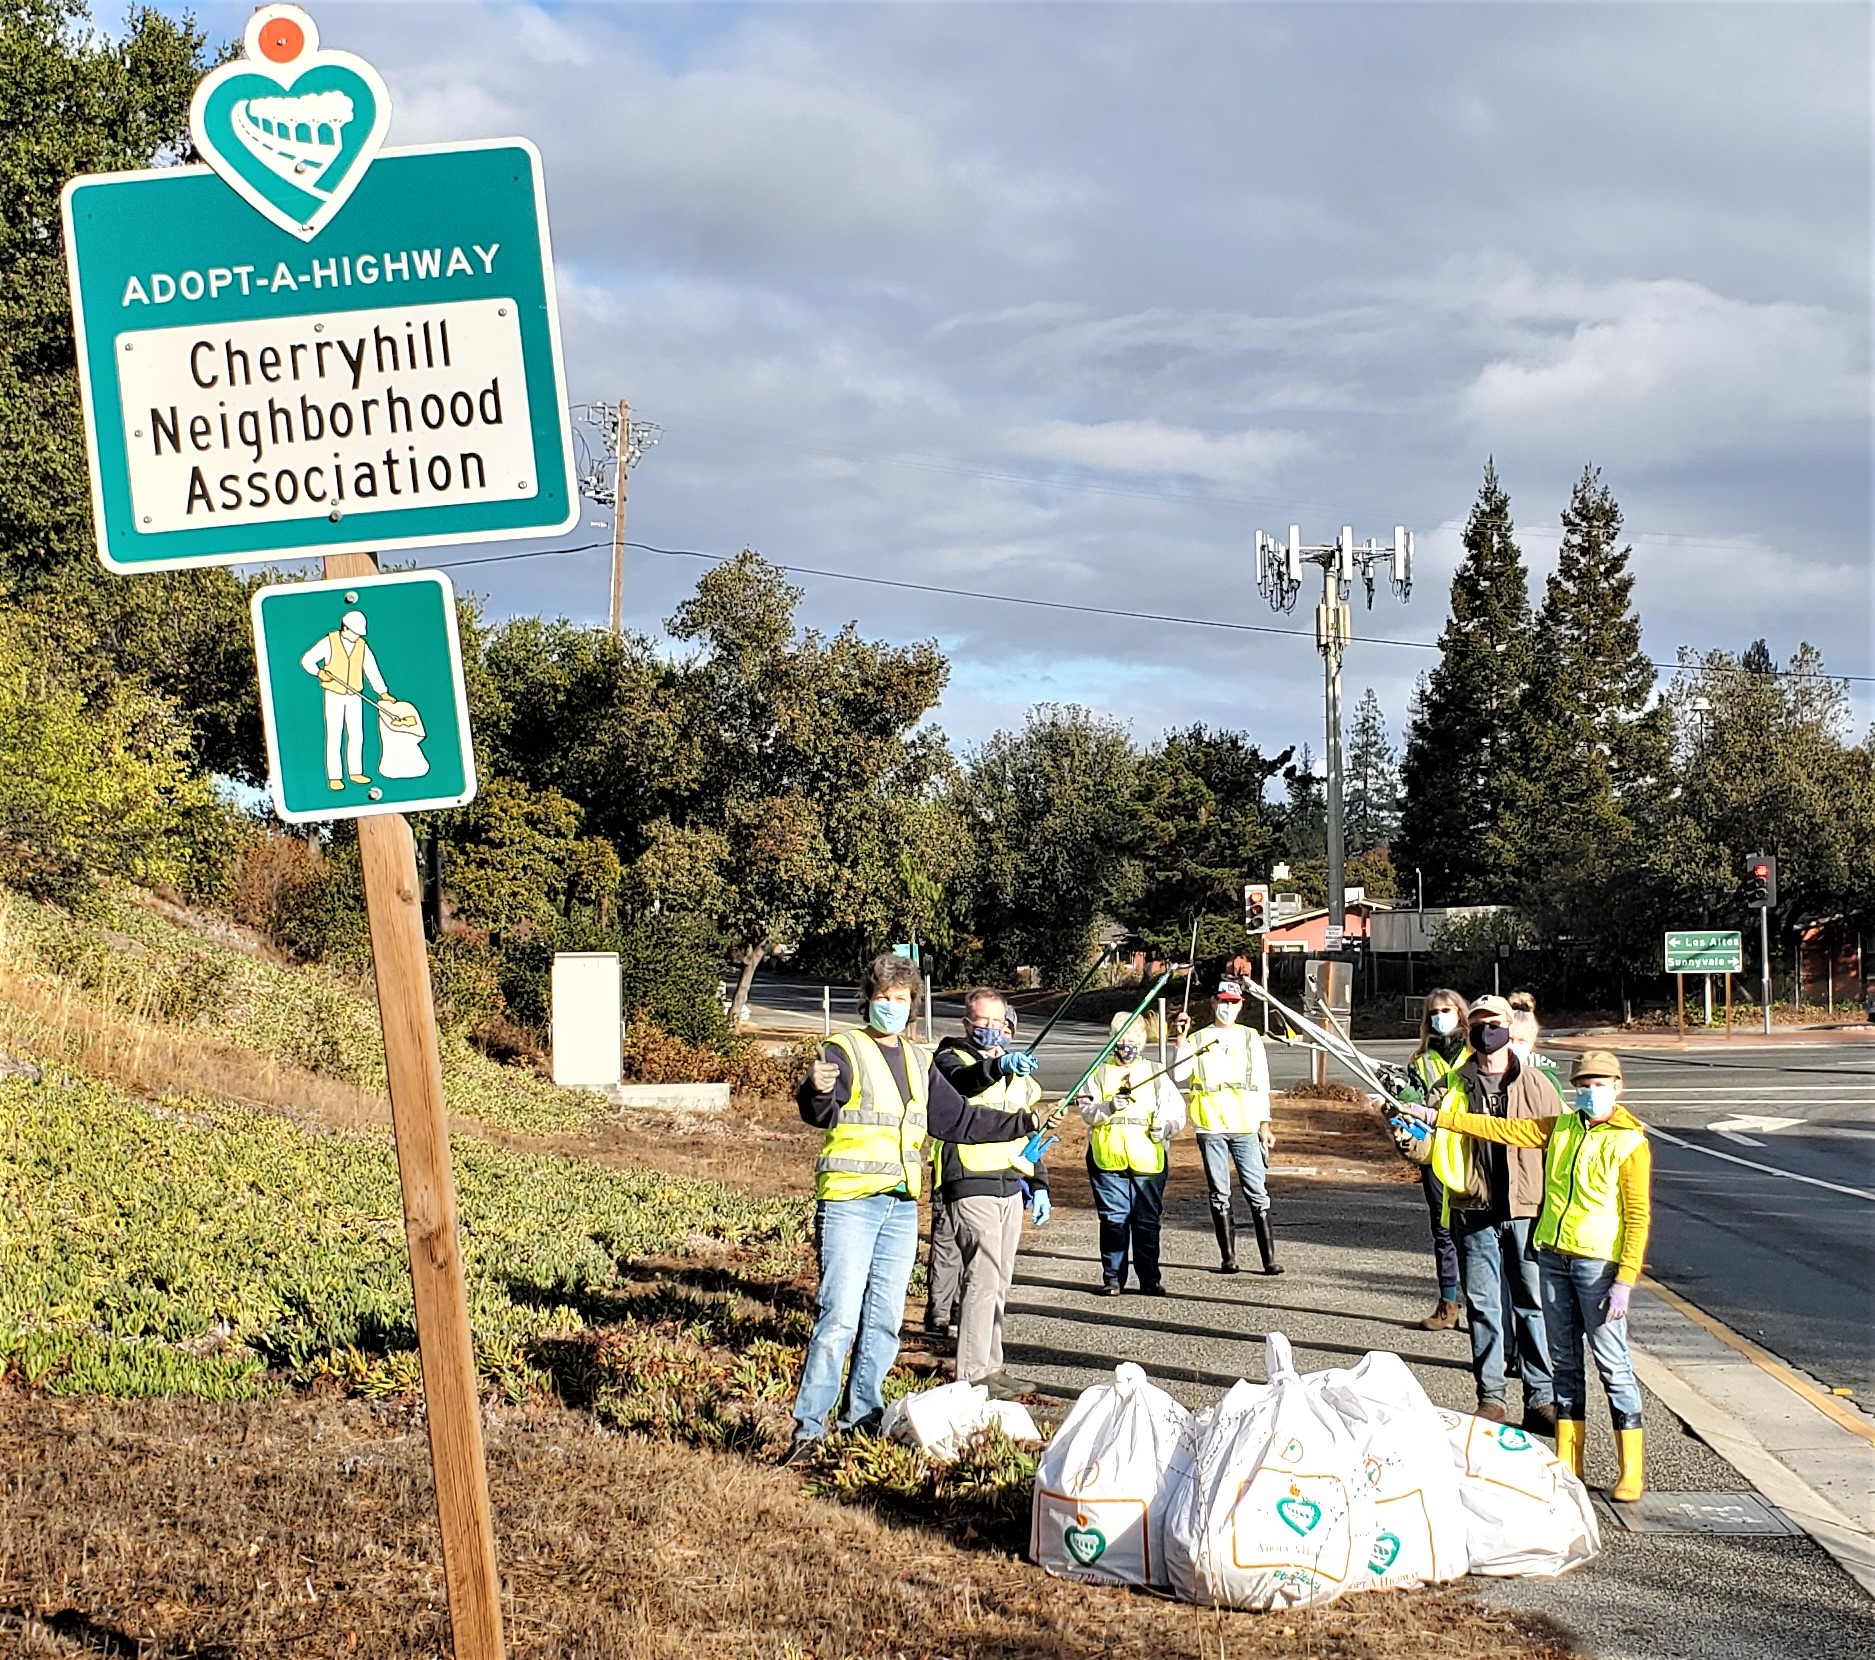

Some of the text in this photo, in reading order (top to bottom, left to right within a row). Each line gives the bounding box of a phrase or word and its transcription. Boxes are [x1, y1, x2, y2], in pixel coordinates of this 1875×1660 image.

[121, 242, 501, 308] ADOPT-A-HIGHWAY
[190, 318, 451, 390] Cherryhill
[150, 376, 503, 464] Neighborhood
[186, 448, 487, 515] Association
[1667, 957, 1725, 968] Sunnyvale
[1685, 937, 1740, 947] Los Altos
